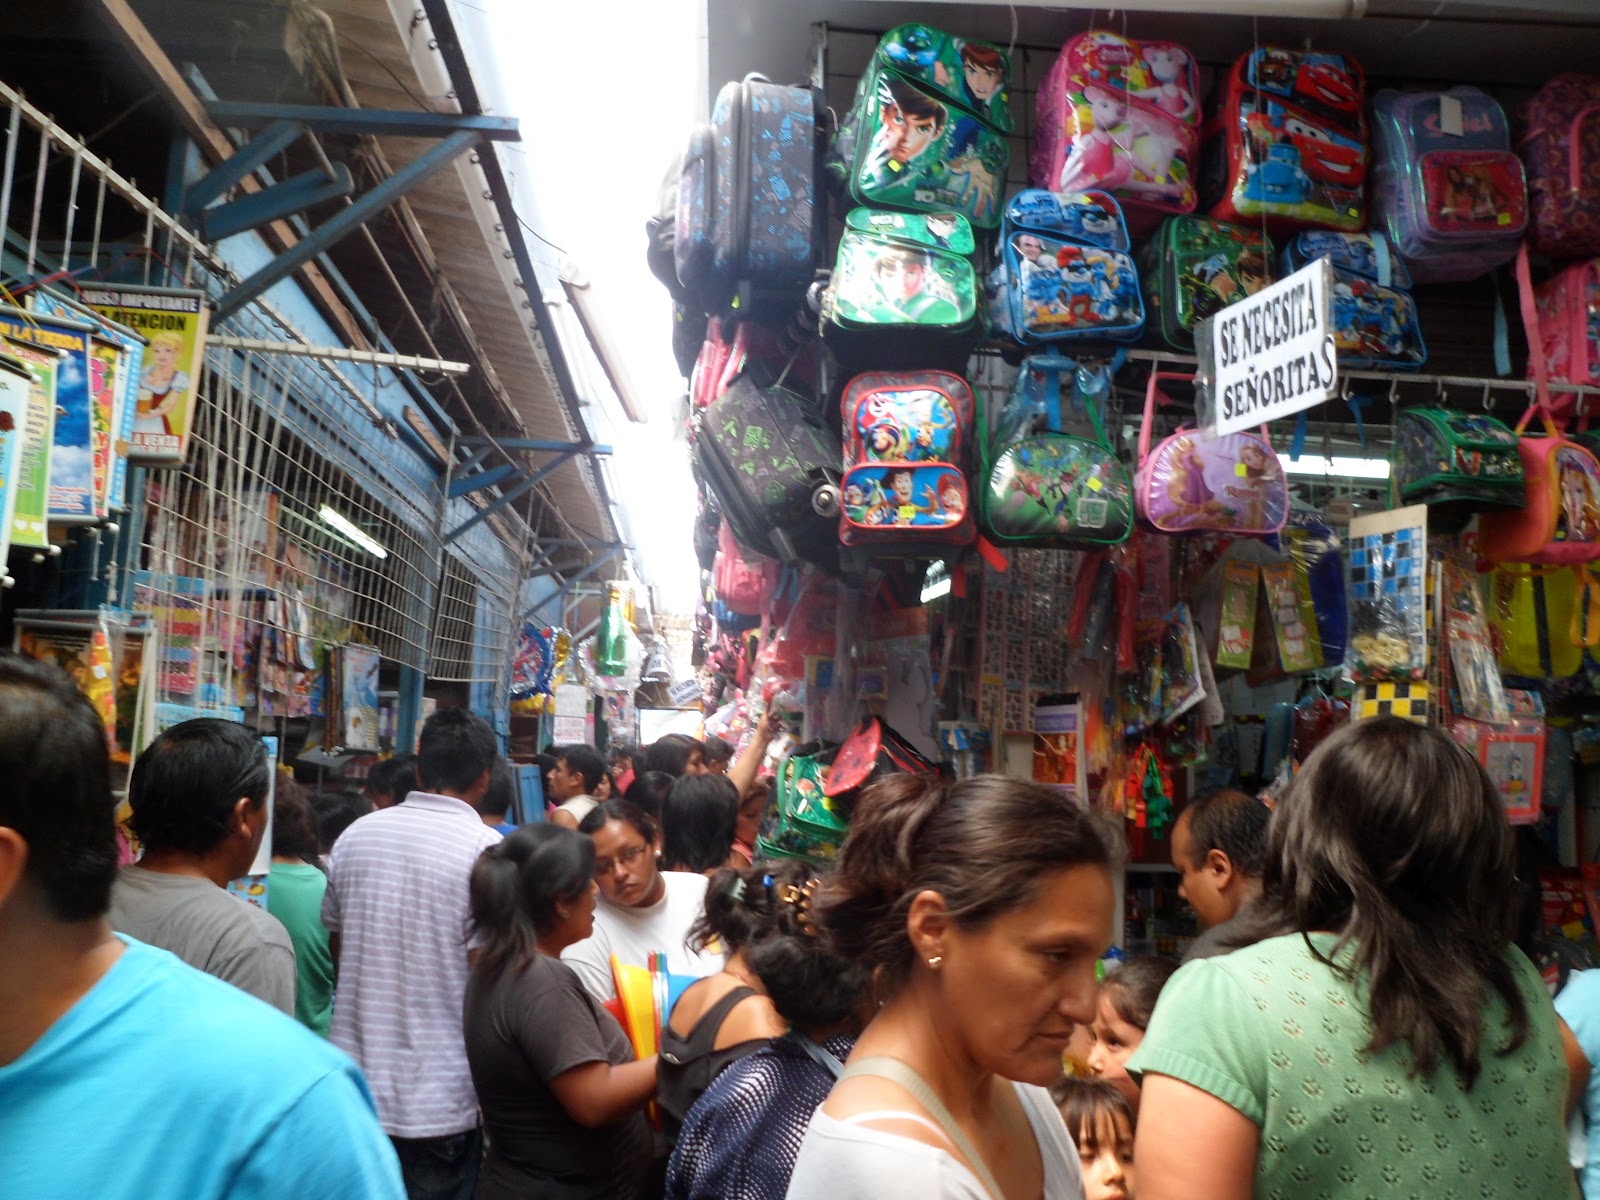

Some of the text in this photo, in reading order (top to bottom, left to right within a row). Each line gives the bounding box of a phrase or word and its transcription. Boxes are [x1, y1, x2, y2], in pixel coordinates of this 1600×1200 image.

[1220, 277, 1317, 368] SE NECESITA
[1223, 334, 1336, 420] SEÑORITAS
